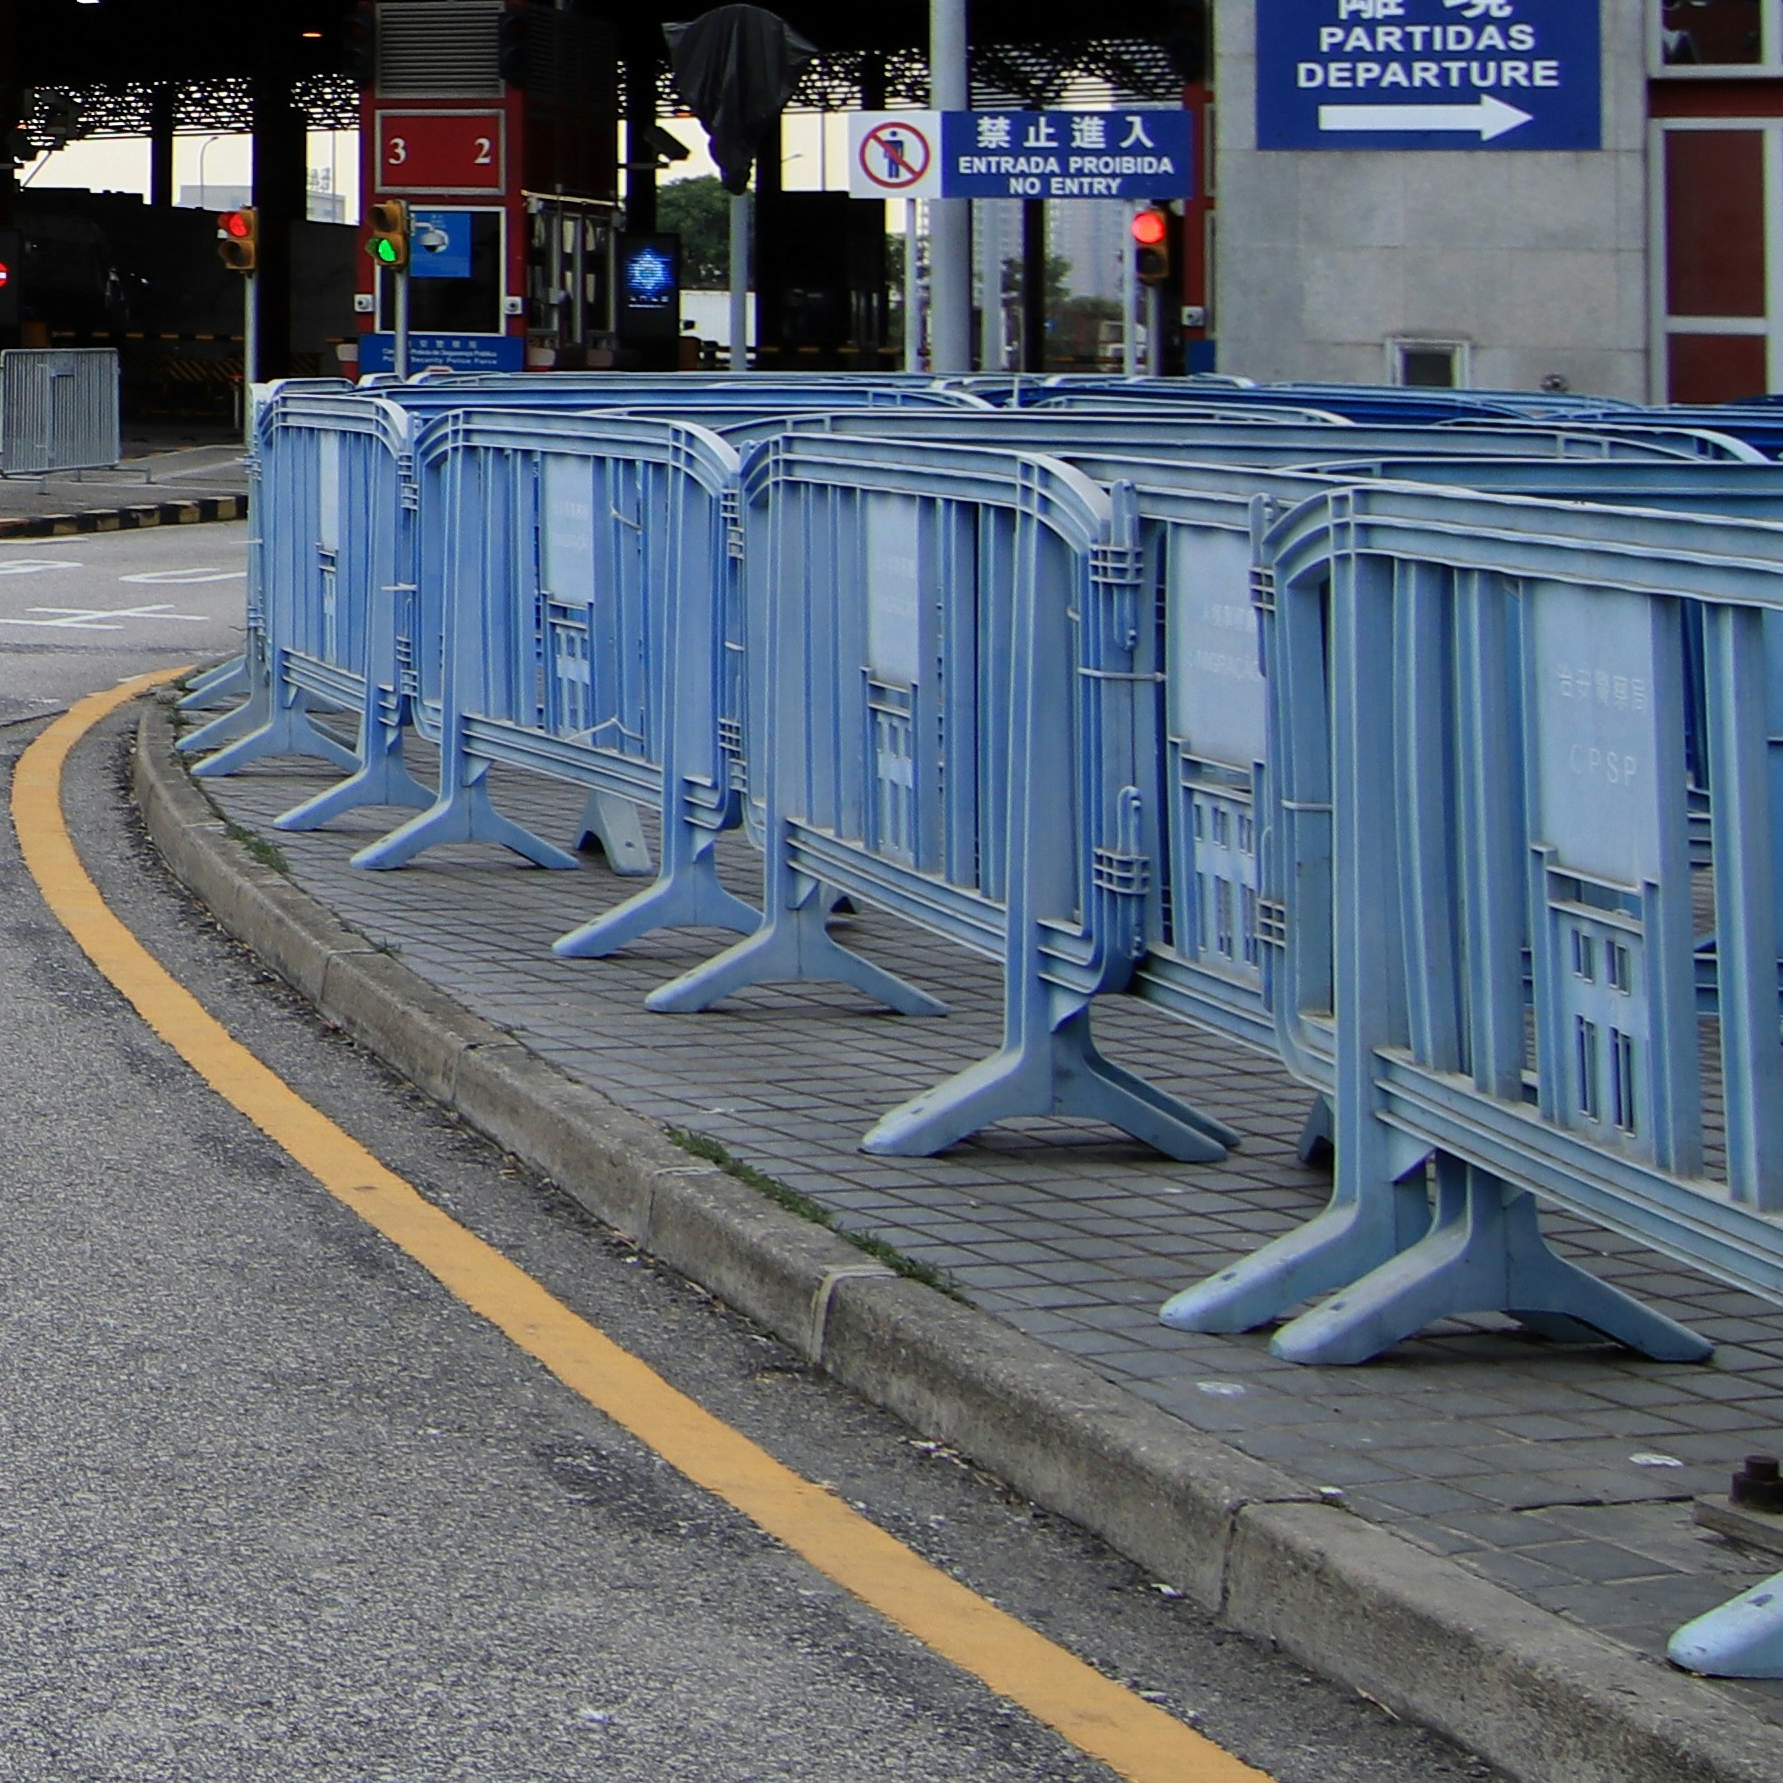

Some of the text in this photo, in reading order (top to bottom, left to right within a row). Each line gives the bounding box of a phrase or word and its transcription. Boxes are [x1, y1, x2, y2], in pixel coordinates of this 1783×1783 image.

[1319, 24, 1535, 52] PARTIDAS
[1297, 61, 1560, 88] DEPARTURE
[976, 116, 1155, 149] 禁止進入
[388, 138, 491, 165] 3 2
[958, 156, 1175, 175] ENTRADA PROIBIDA
[1009, 177, 1122, 195] NO ENTRY
[1570, 744, 1637, 785] CPSP
